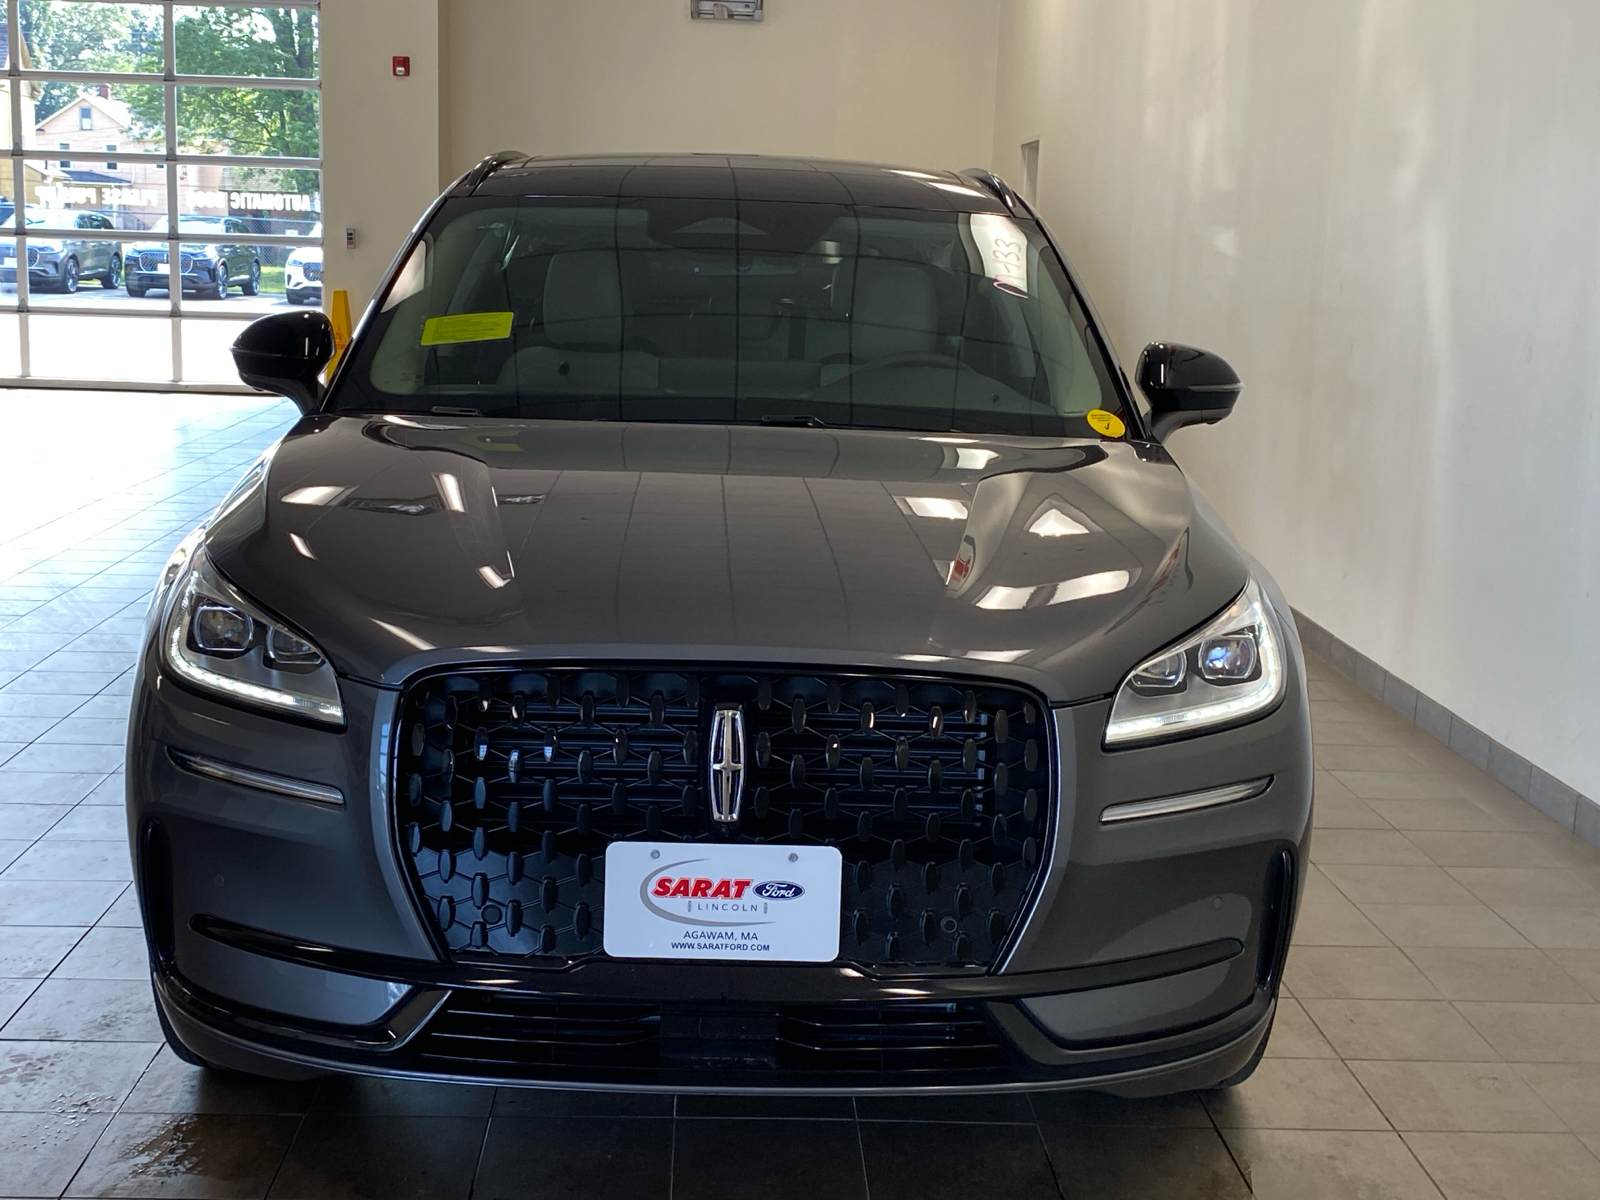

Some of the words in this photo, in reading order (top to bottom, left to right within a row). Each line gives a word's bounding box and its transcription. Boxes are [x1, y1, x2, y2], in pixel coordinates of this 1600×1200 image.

[651, 876, 754, 900] SARAT
[761, 882, 796, 898] Ford
[697, 902, 758, 912] LINCOLN
[683, 930, 738, 941] AGAWAM,
[740, 931, 759, 941] MA
[671, 941, 770, 952] WWW.SARATFORD.COM
